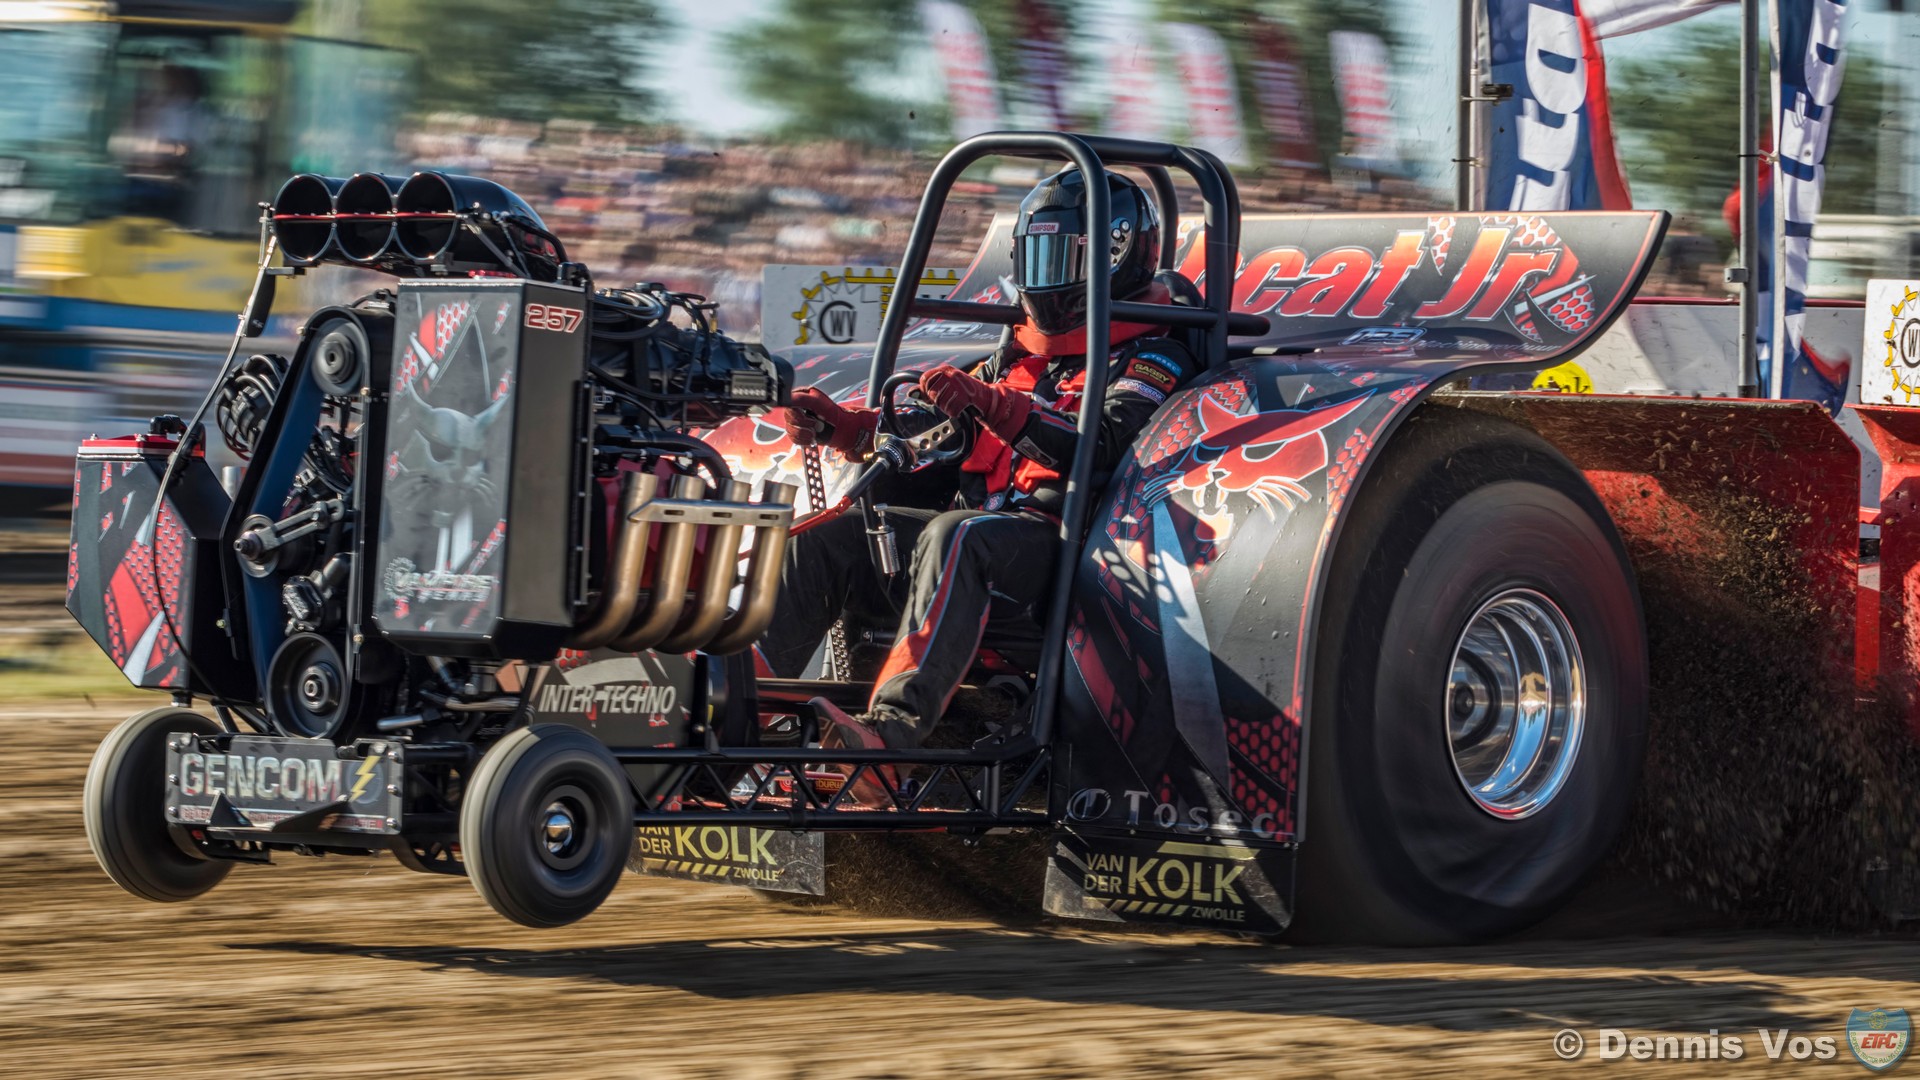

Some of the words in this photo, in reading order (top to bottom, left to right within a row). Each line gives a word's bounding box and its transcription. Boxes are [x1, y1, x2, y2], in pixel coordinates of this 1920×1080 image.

[1030, 223, 1057, 233] SIMPSON
[1411, 225, 1563, 321] Jr
[524, 303, 584, 333] 257
[538, 684, 676, 714] INTER-TECHNO
[180, 753, 342, 802] GENCOM
[638, 836, 673, 856] DER
[674, 826, 778, 866] KOLK
[733, 866, 780, 882] ZWOLLE
[1086, 853, 1124, 873] VAN
[1084, 873, 1122, 894] DER
[1127, 856, 1246, 905] KOLK
[1191, 906, 1246, 922] ZWOLLE
